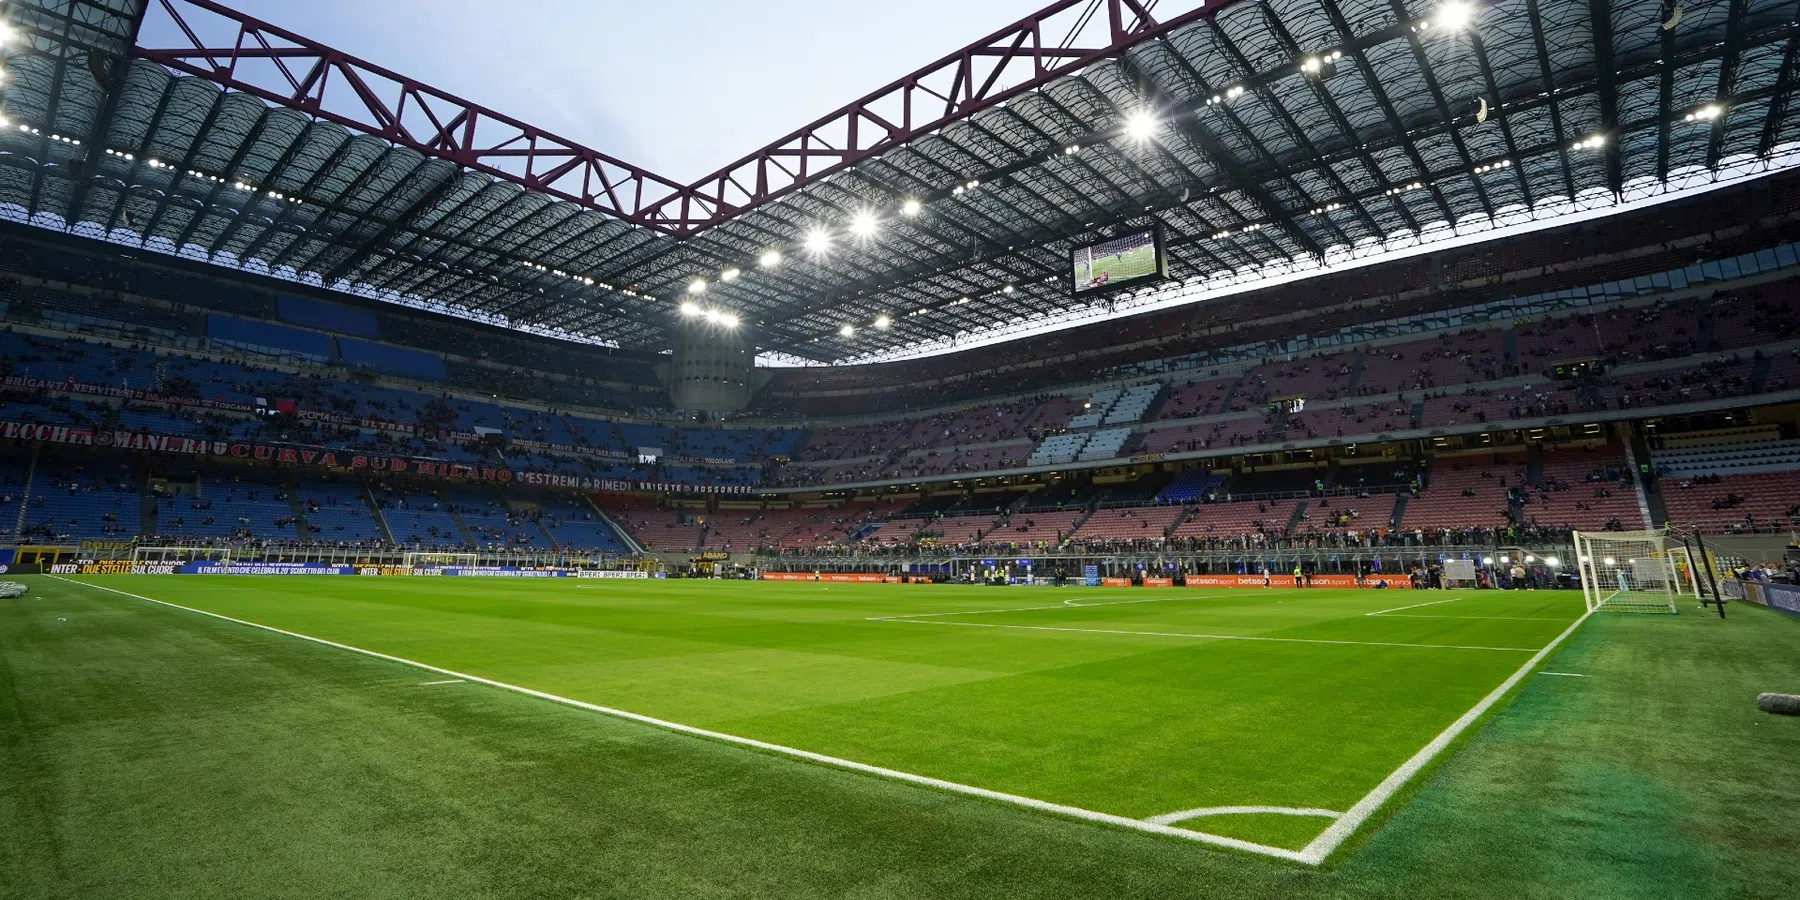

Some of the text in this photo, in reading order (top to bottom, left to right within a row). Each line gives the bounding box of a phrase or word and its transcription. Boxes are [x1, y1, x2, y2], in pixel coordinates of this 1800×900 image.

[5, 376, 134, 398] BRIGANTI NERVITESI
[215, 401, 252, 411] TOSCANA
[298, 410, 329, 421] ROMA
[361, 419, 414, 432] ULTRAS
[113, 431, 206, 455] MANIRA
[231, 444, 512, 481] CURVA SUD MILANO
[594, 480, 631, 491] RIMEDI
[640, 482, 752, 494] BRIGATE ROSSONERE
[51, 564, 78, 574] INTER
[82, 564, 101, 574] DUE
[101, 564, 131, 574] STELLE
[148, 564, 175, 574] CUORE
[251, 567, 275, 575] CELEBRA
[289, 567, 317, 575] SCUDETTO
[361, 568, 378, 576] INTER
